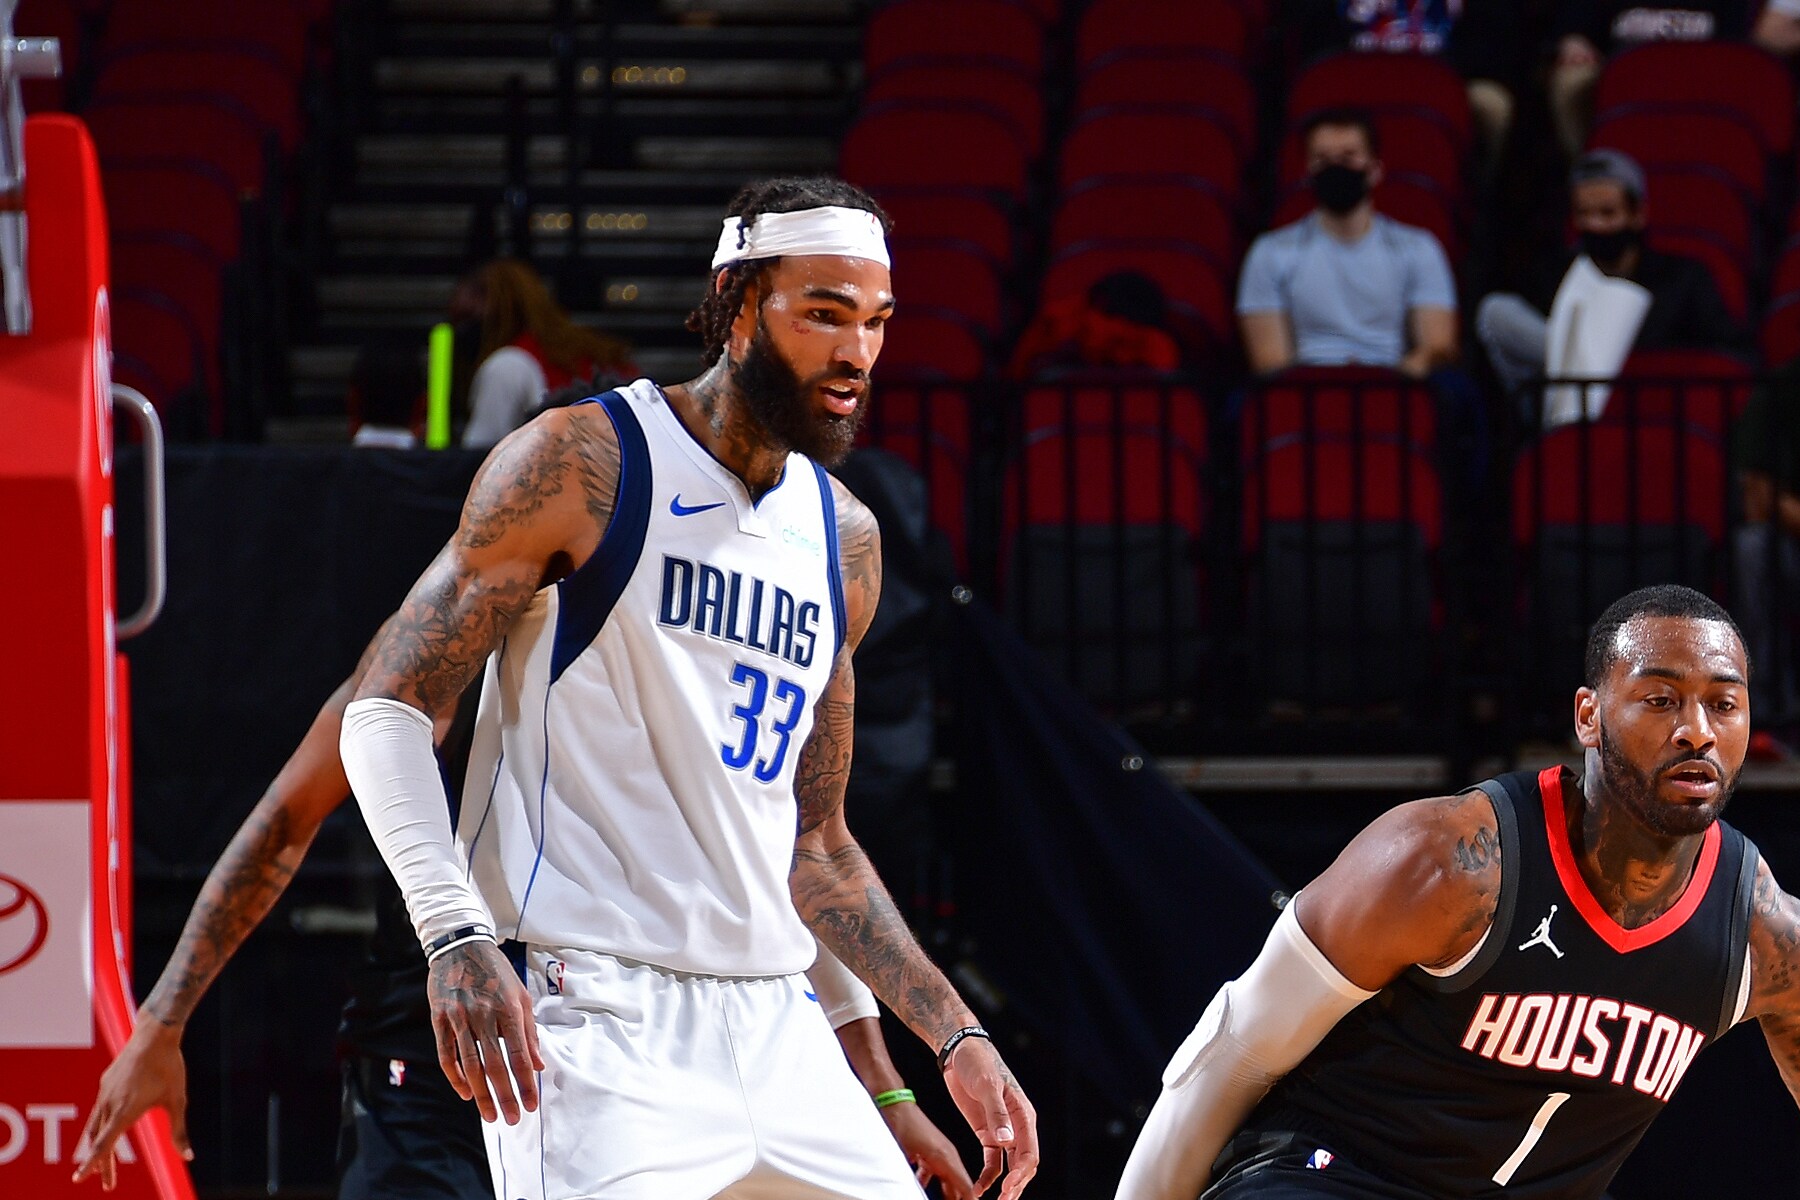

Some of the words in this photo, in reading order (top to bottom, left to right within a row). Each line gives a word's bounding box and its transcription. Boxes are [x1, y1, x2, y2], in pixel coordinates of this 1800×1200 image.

[657, 552, 820, 671] DALLAS
[720, 660, 806, 785] 33
[1460, 993, 1707, 1103] HOUSTON
[1491, 1092, 1571, 1187] 1
